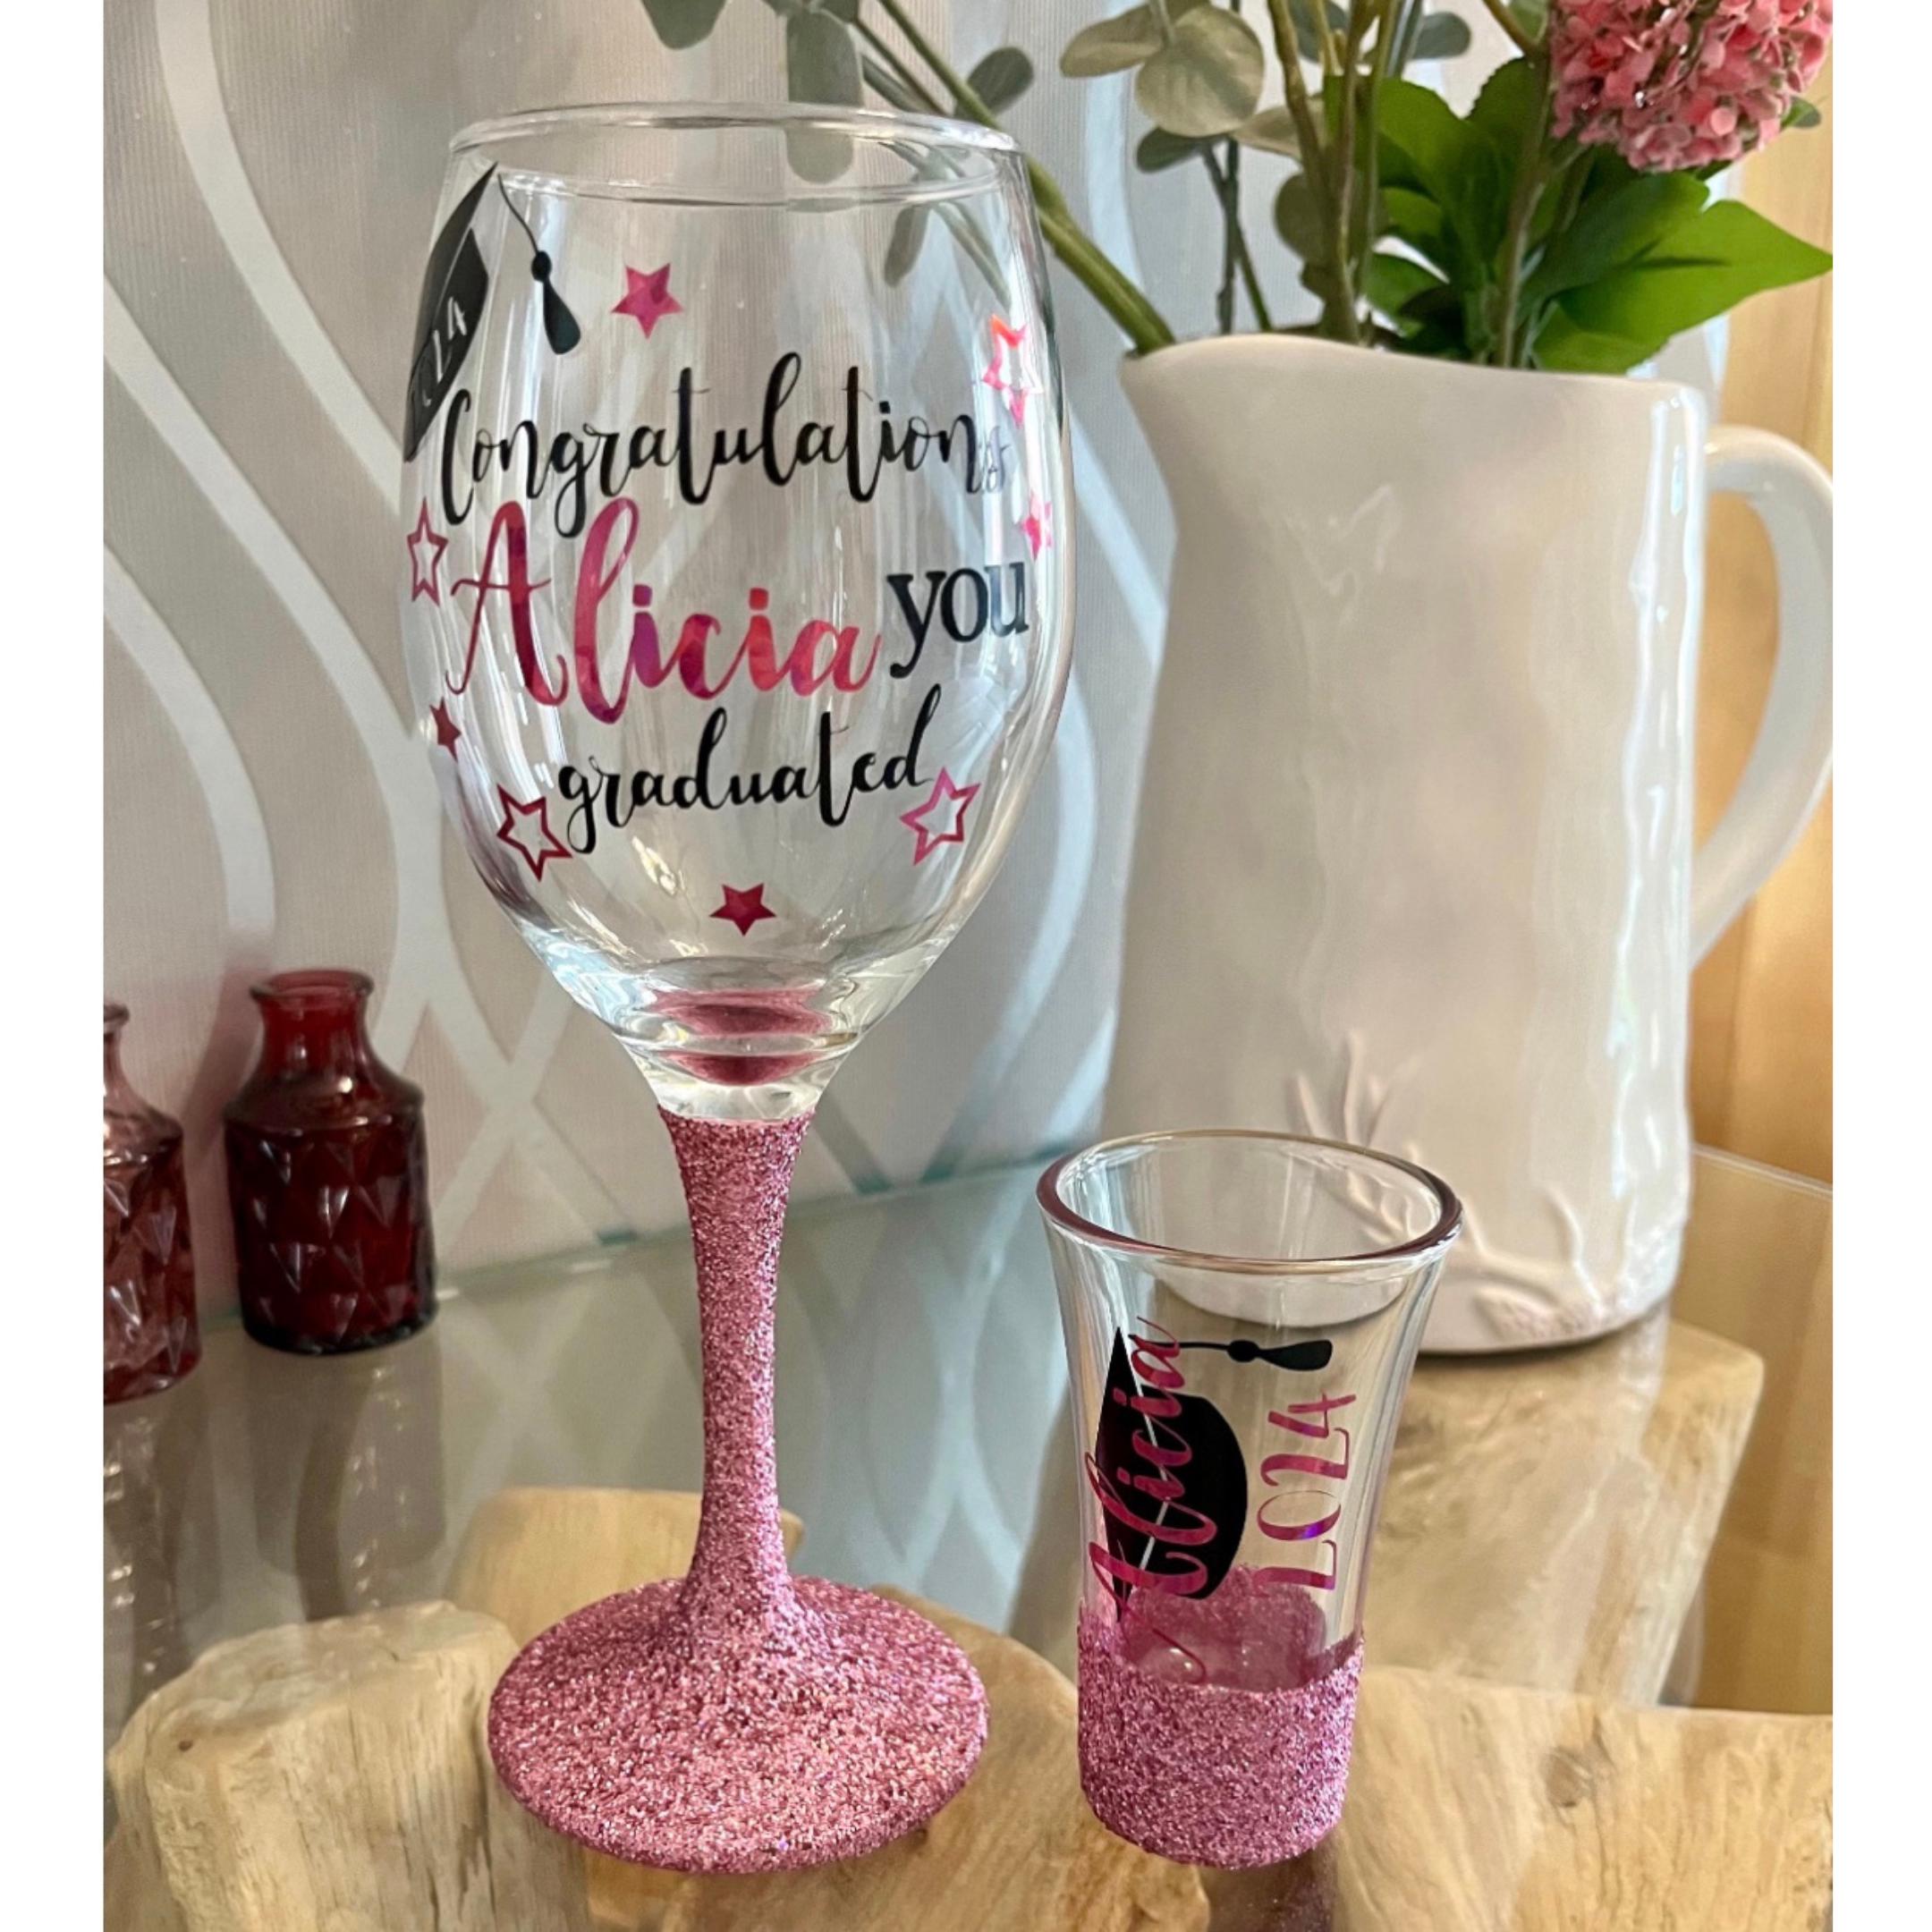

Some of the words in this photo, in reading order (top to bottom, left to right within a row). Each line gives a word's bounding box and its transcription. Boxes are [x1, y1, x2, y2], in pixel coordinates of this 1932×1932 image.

[441, 352, 1010, 539] Congratulations
[445, 496, 882, 724] Alicia
[886, 561, 1030, 679] you
[558, 683, 942, 855] graduated
[1084, 1316, 1218, 1685] Alicia
